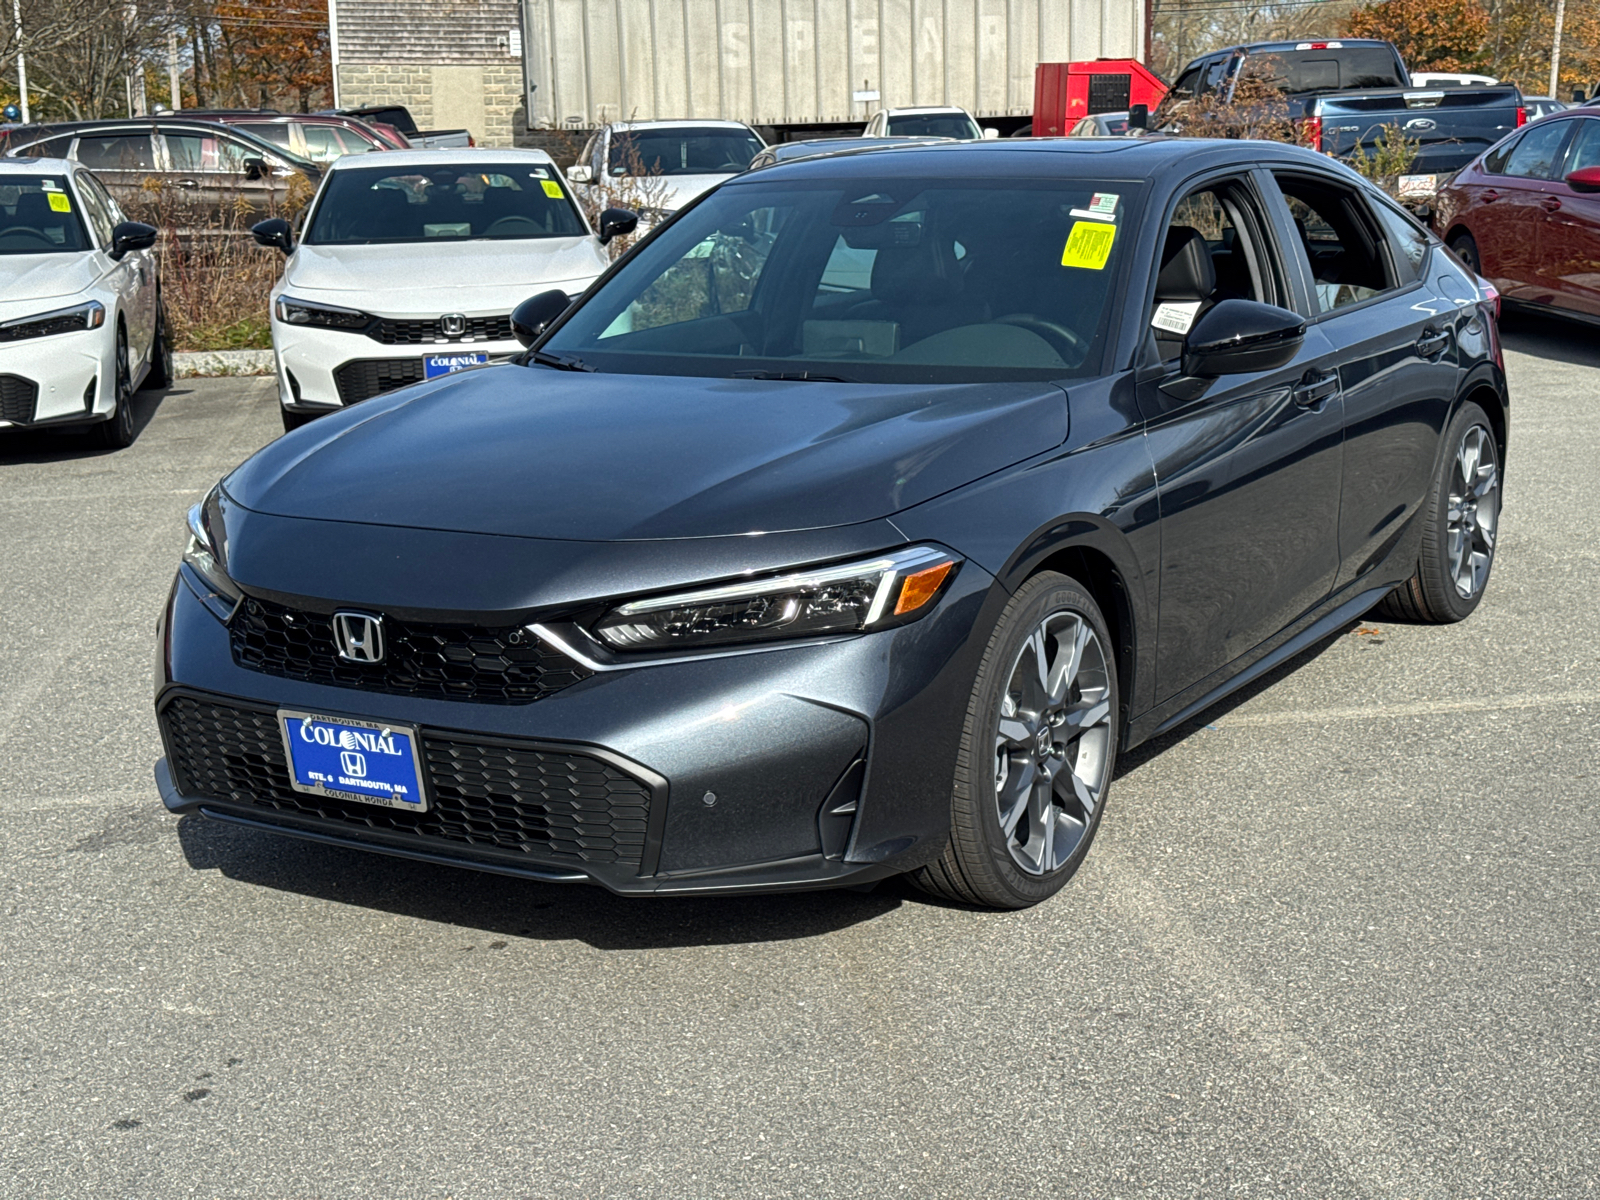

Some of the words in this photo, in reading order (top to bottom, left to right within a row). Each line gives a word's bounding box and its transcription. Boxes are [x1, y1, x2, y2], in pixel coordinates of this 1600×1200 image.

[430, 354, 481, 367] COLONIAL
[300, 724, 402, 756] COLONIAL
[327, 774, 334, 783] 6
[338, 776, 394, 793] DARTMOUTH,
[394, 784, 408, 794] MA
[324, 789, 363, 802] COLONIAL
[365, 796, 394, 807] HONDA
